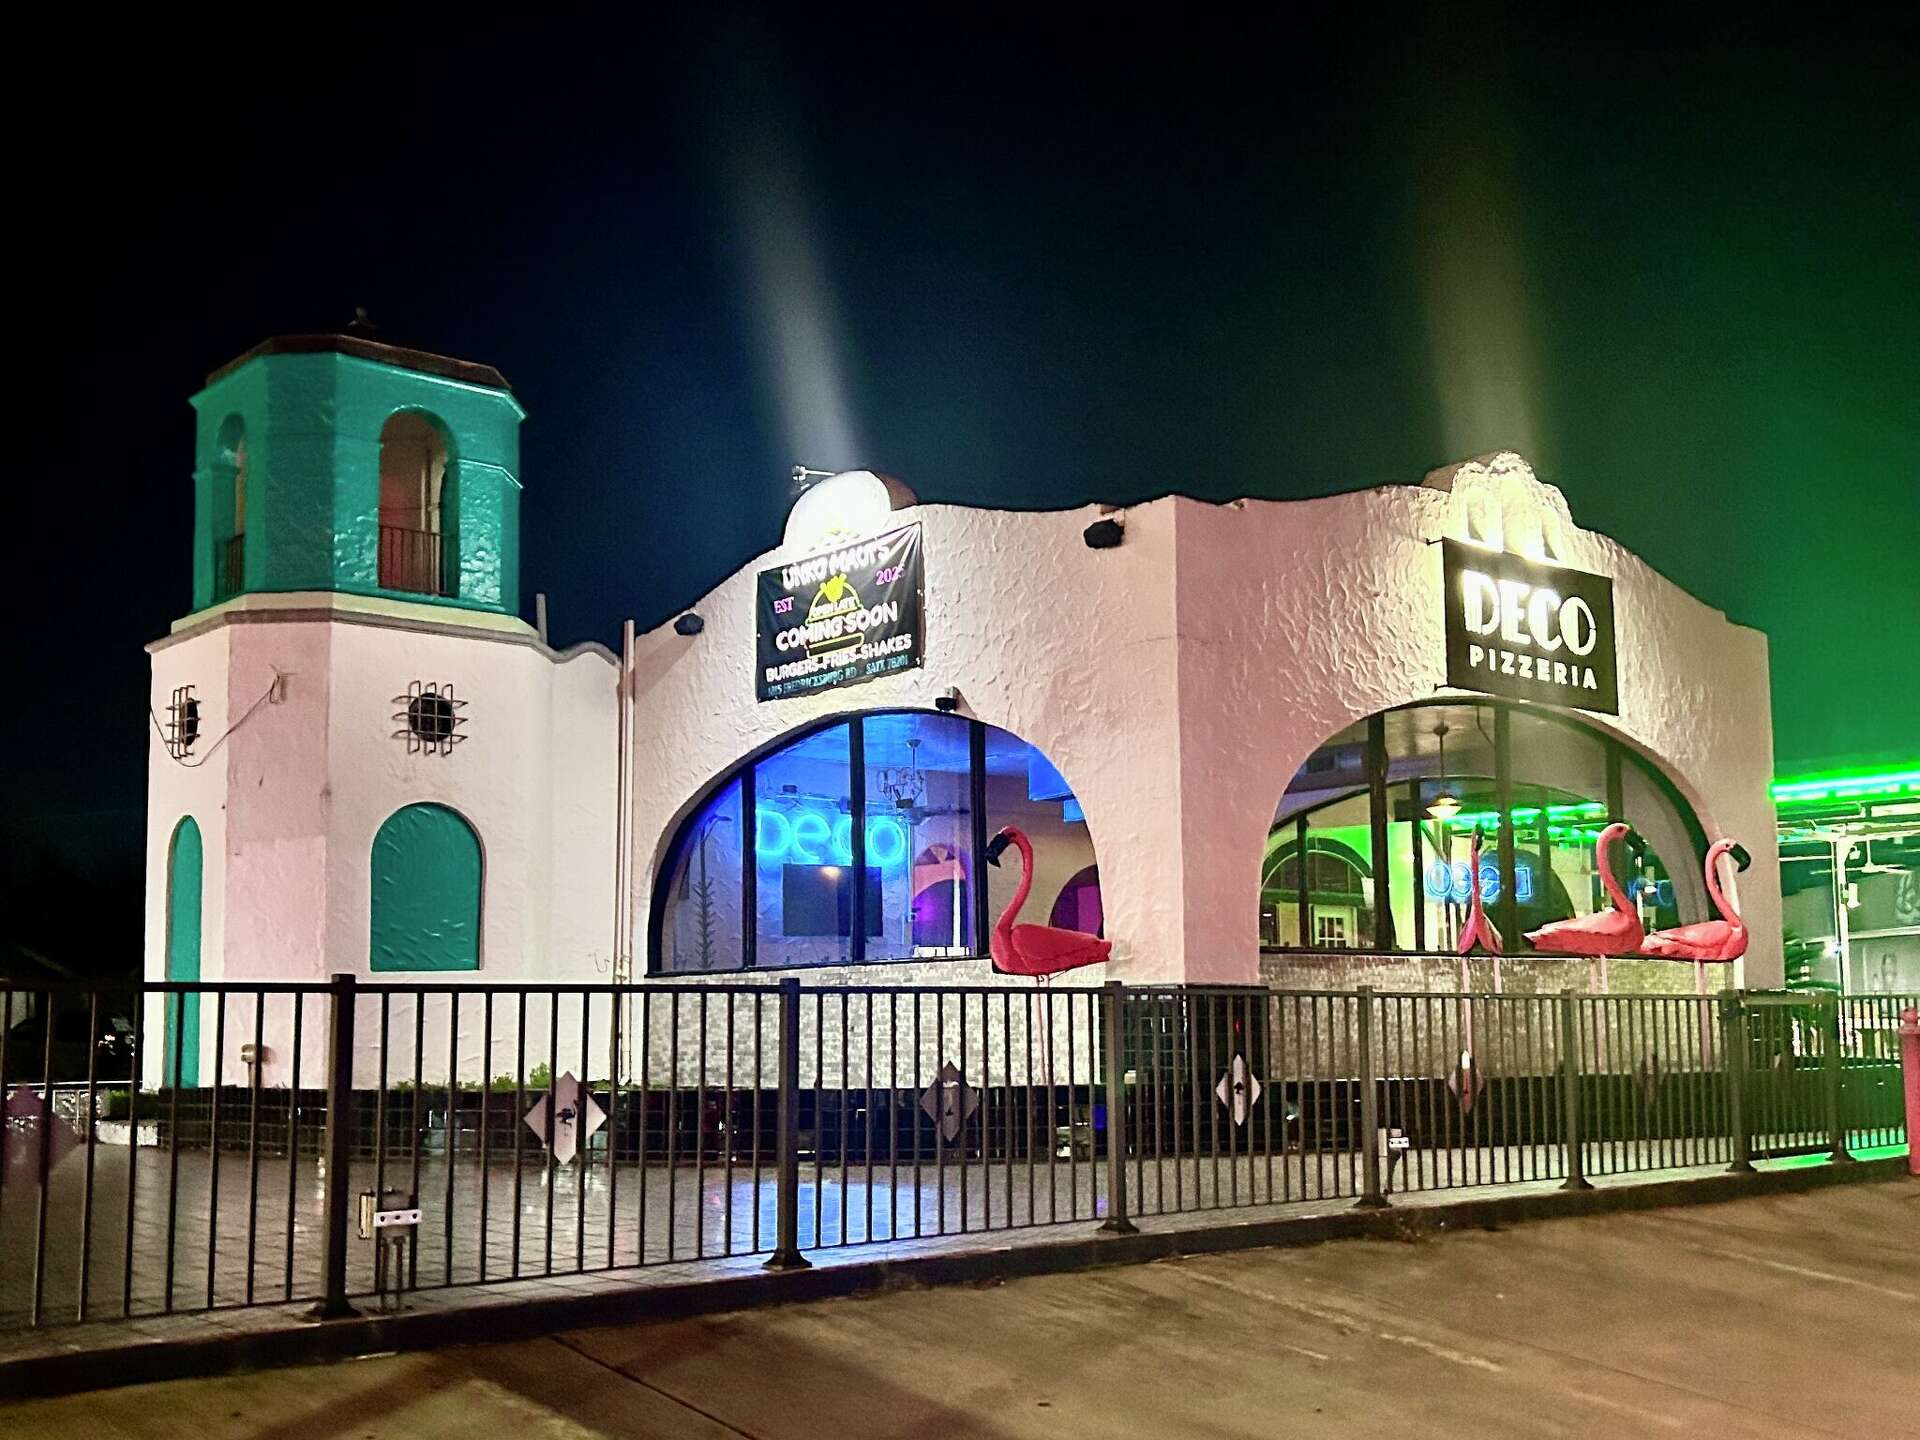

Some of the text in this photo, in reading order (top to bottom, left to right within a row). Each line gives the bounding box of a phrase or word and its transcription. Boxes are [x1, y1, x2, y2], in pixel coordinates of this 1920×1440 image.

[773, 597, 795, 614] EST
[775, 600, 898, 651] COMING SOON
[1462, 568, 1597, 656] DECO
[1468, 644, 1598, 690] PIZZERIA
